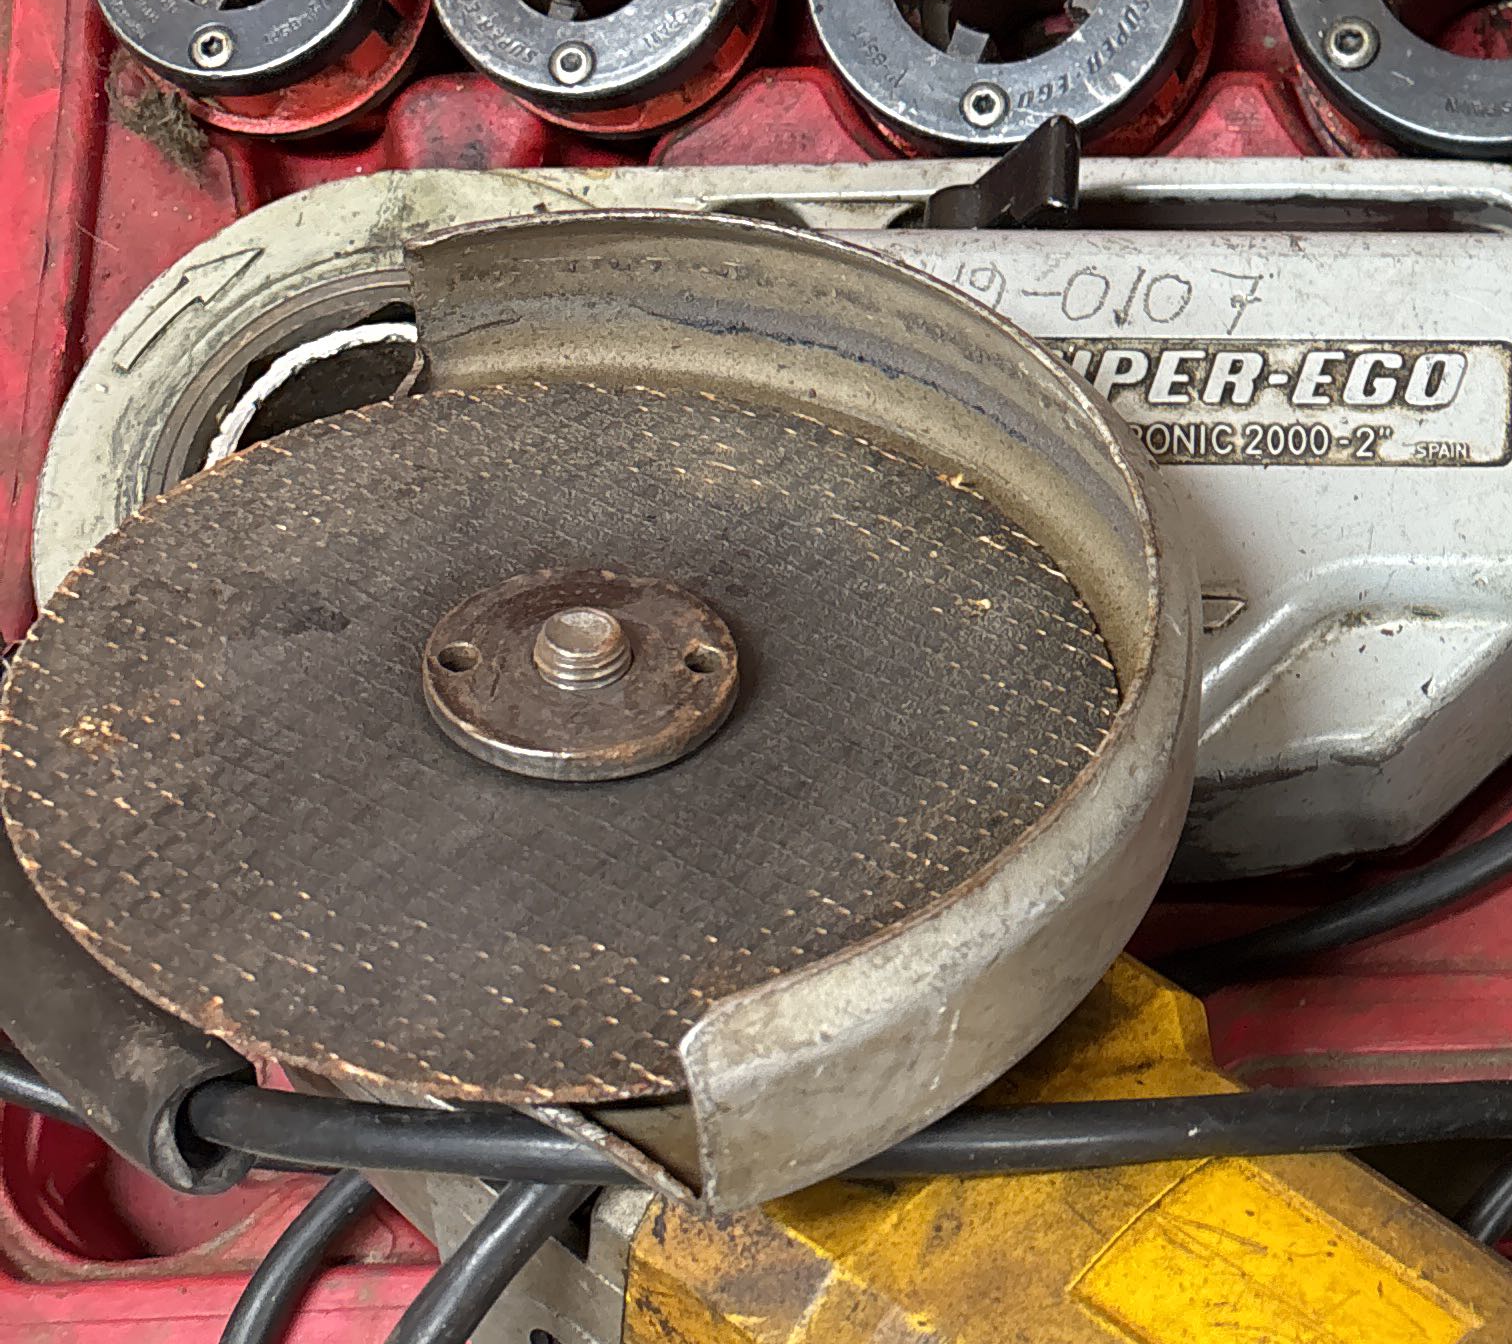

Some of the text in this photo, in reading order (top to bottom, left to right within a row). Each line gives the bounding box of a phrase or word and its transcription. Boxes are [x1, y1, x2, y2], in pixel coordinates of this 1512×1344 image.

[1053, 348, 1469, 407] PER-EGO
[1130, 423, 1234, 456] ONIC
[1414, 442, 1470, 460] SPAIN
